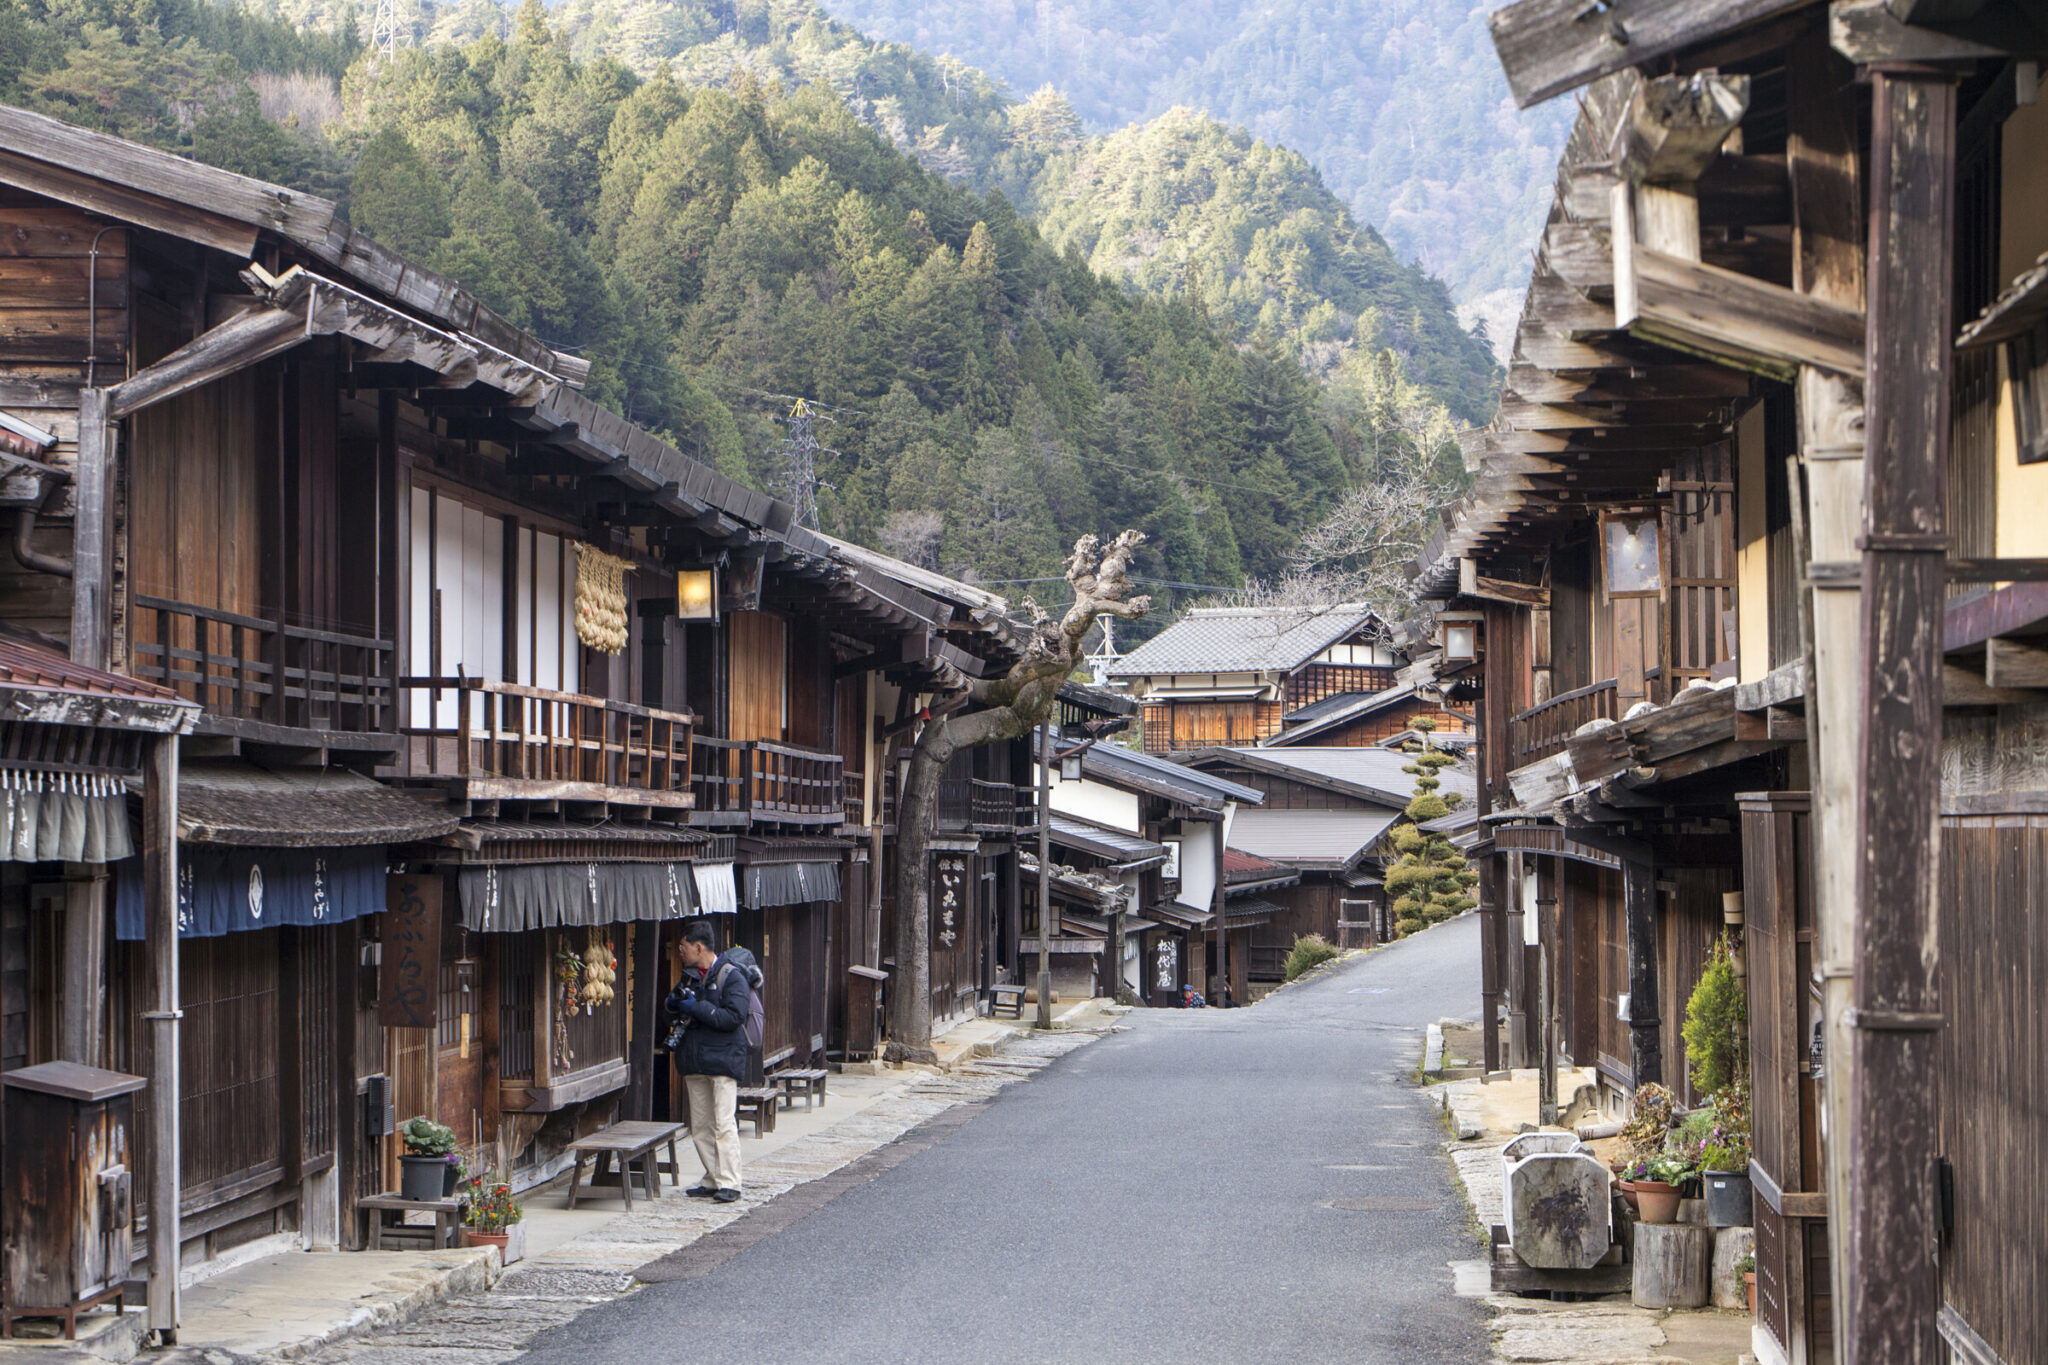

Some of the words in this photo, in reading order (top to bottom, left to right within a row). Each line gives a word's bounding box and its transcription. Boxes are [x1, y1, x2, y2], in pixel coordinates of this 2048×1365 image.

[389, 880, 428, 1027] あぶらや
[1156, 938, 1172, 988] 松代屋
